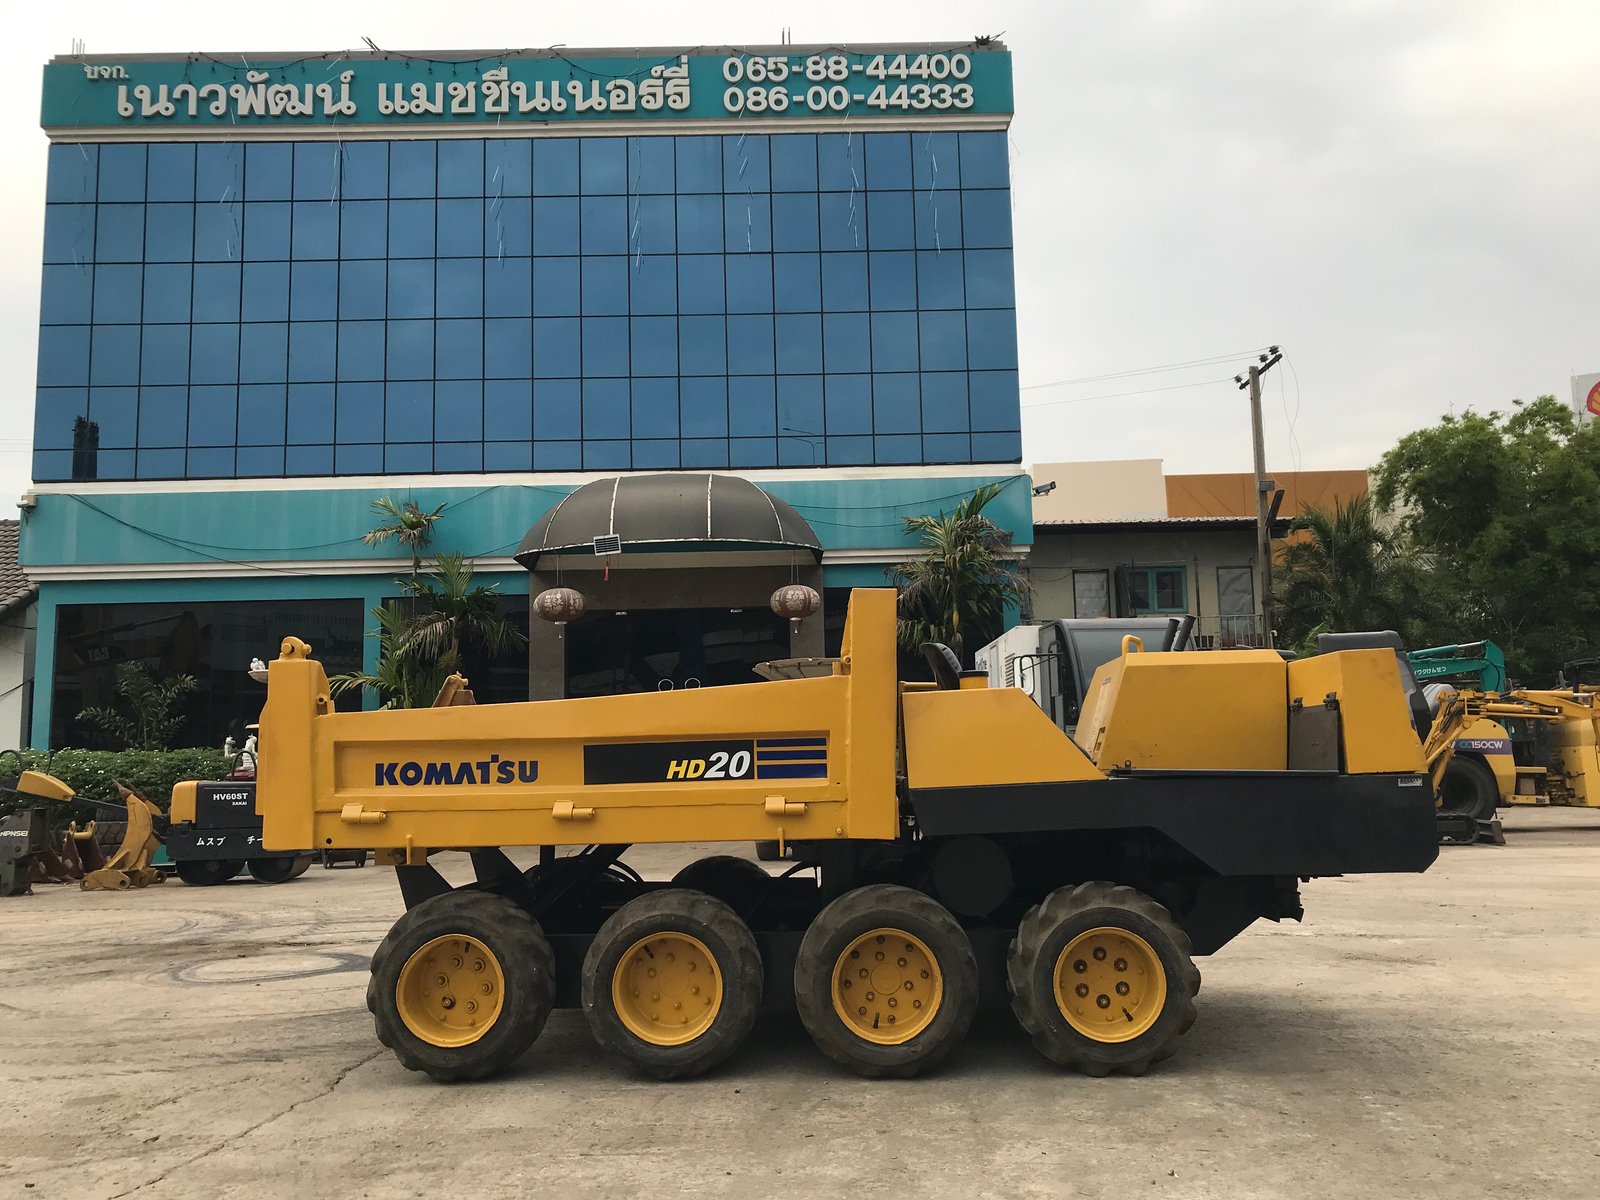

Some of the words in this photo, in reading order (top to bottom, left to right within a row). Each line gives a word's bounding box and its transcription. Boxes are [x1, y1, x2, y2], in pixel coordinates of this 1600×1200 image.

[83, 65, 130, 79] บจก.
[723, 53, 972, 83] 065-88-44400
[117, 70, 357, 117] เนาวพัฒน์
[377, 55, 691, 115] แมชชีนเนอร์รี่
[723, 84, 974, 112] 086-00-44333
[375, 754, 539, 787] KOMATSU
[666, 750, 751, 779] HD20
[213, 793, 249, 801] HV60ST
